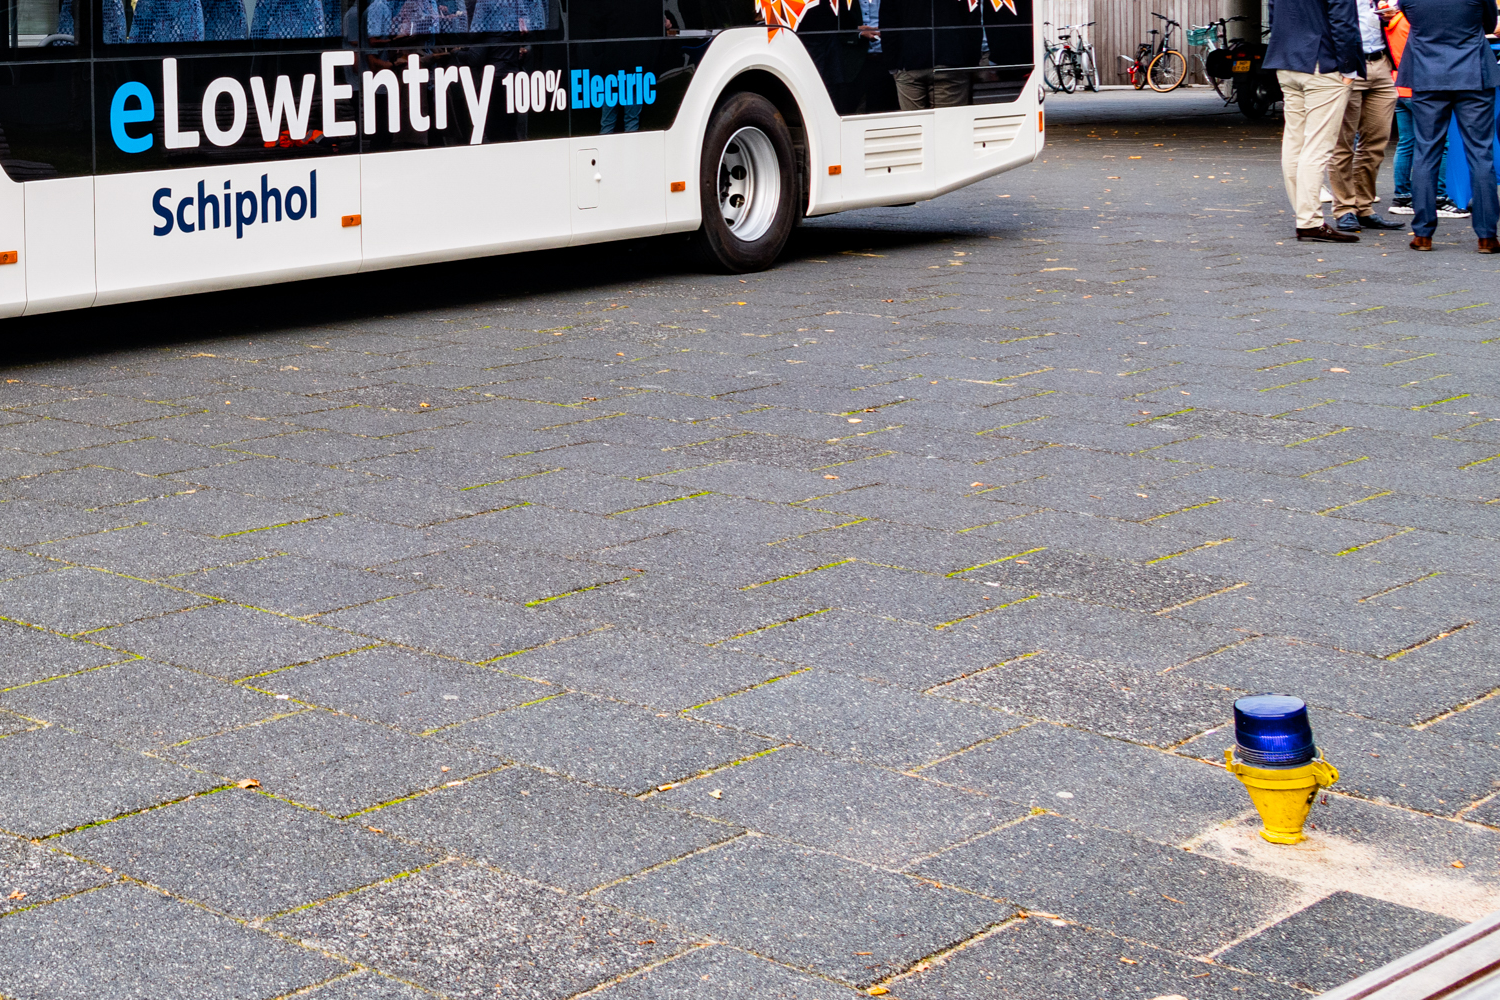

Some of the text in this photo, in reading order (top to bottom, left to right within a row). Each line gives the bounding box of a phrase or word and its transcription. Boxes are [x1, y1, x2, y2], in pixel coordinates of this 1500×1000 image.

[111, 51, 657, 154] eLowEntry 100% Electric
[152, 169, 317, 239] Schiphol
